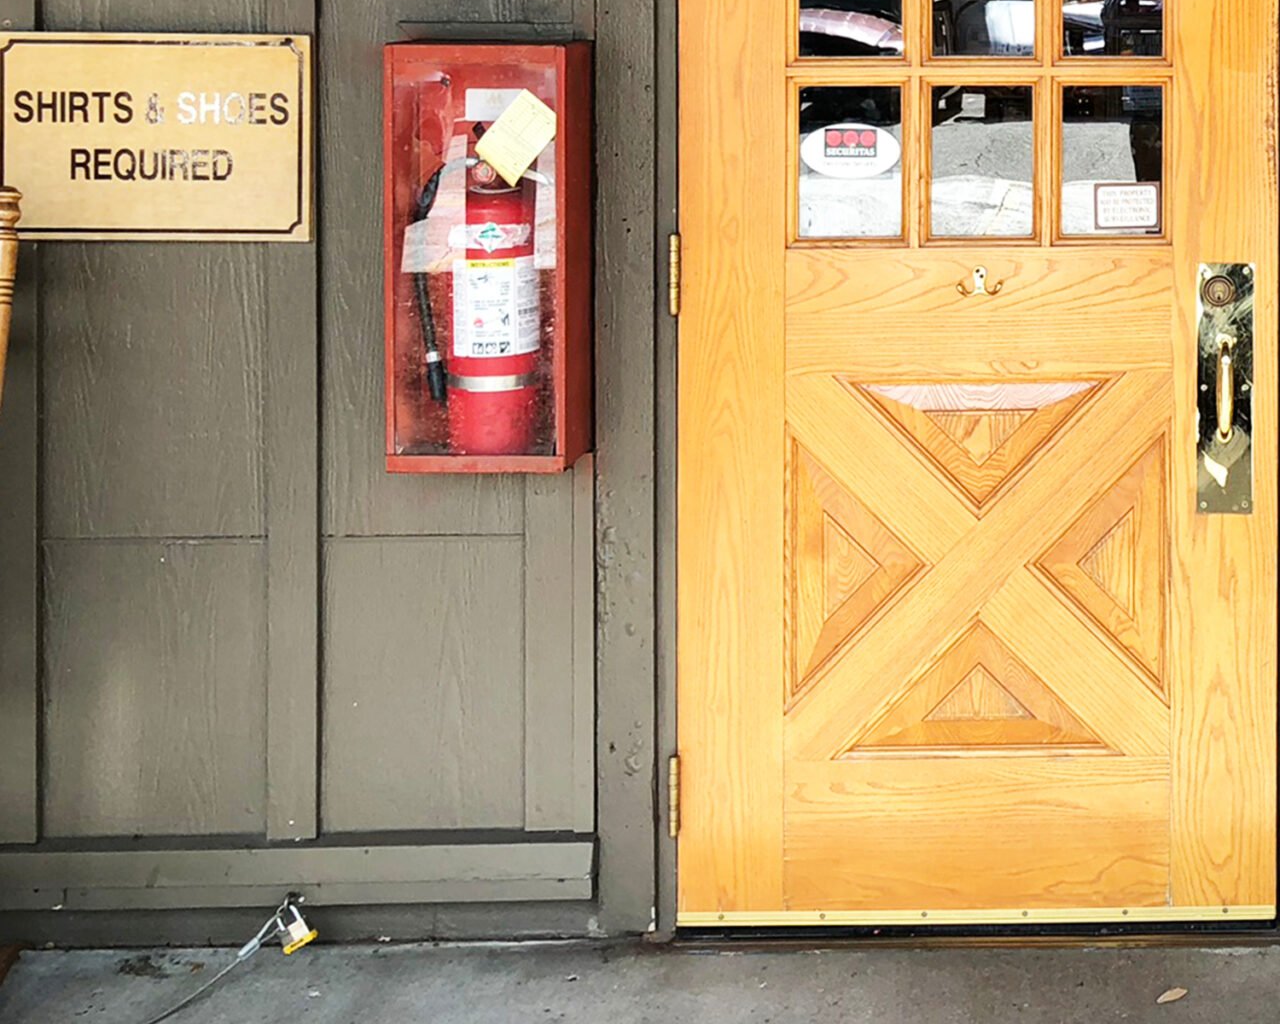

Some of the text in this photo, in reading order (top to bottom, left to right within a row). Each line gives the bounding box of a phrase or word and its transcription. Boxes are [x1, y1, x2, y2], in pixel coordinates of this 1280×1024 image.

[13, 90, 289, 125] SHIRTS & SHOES
[70, 148, 234, 182] REQUIRED
